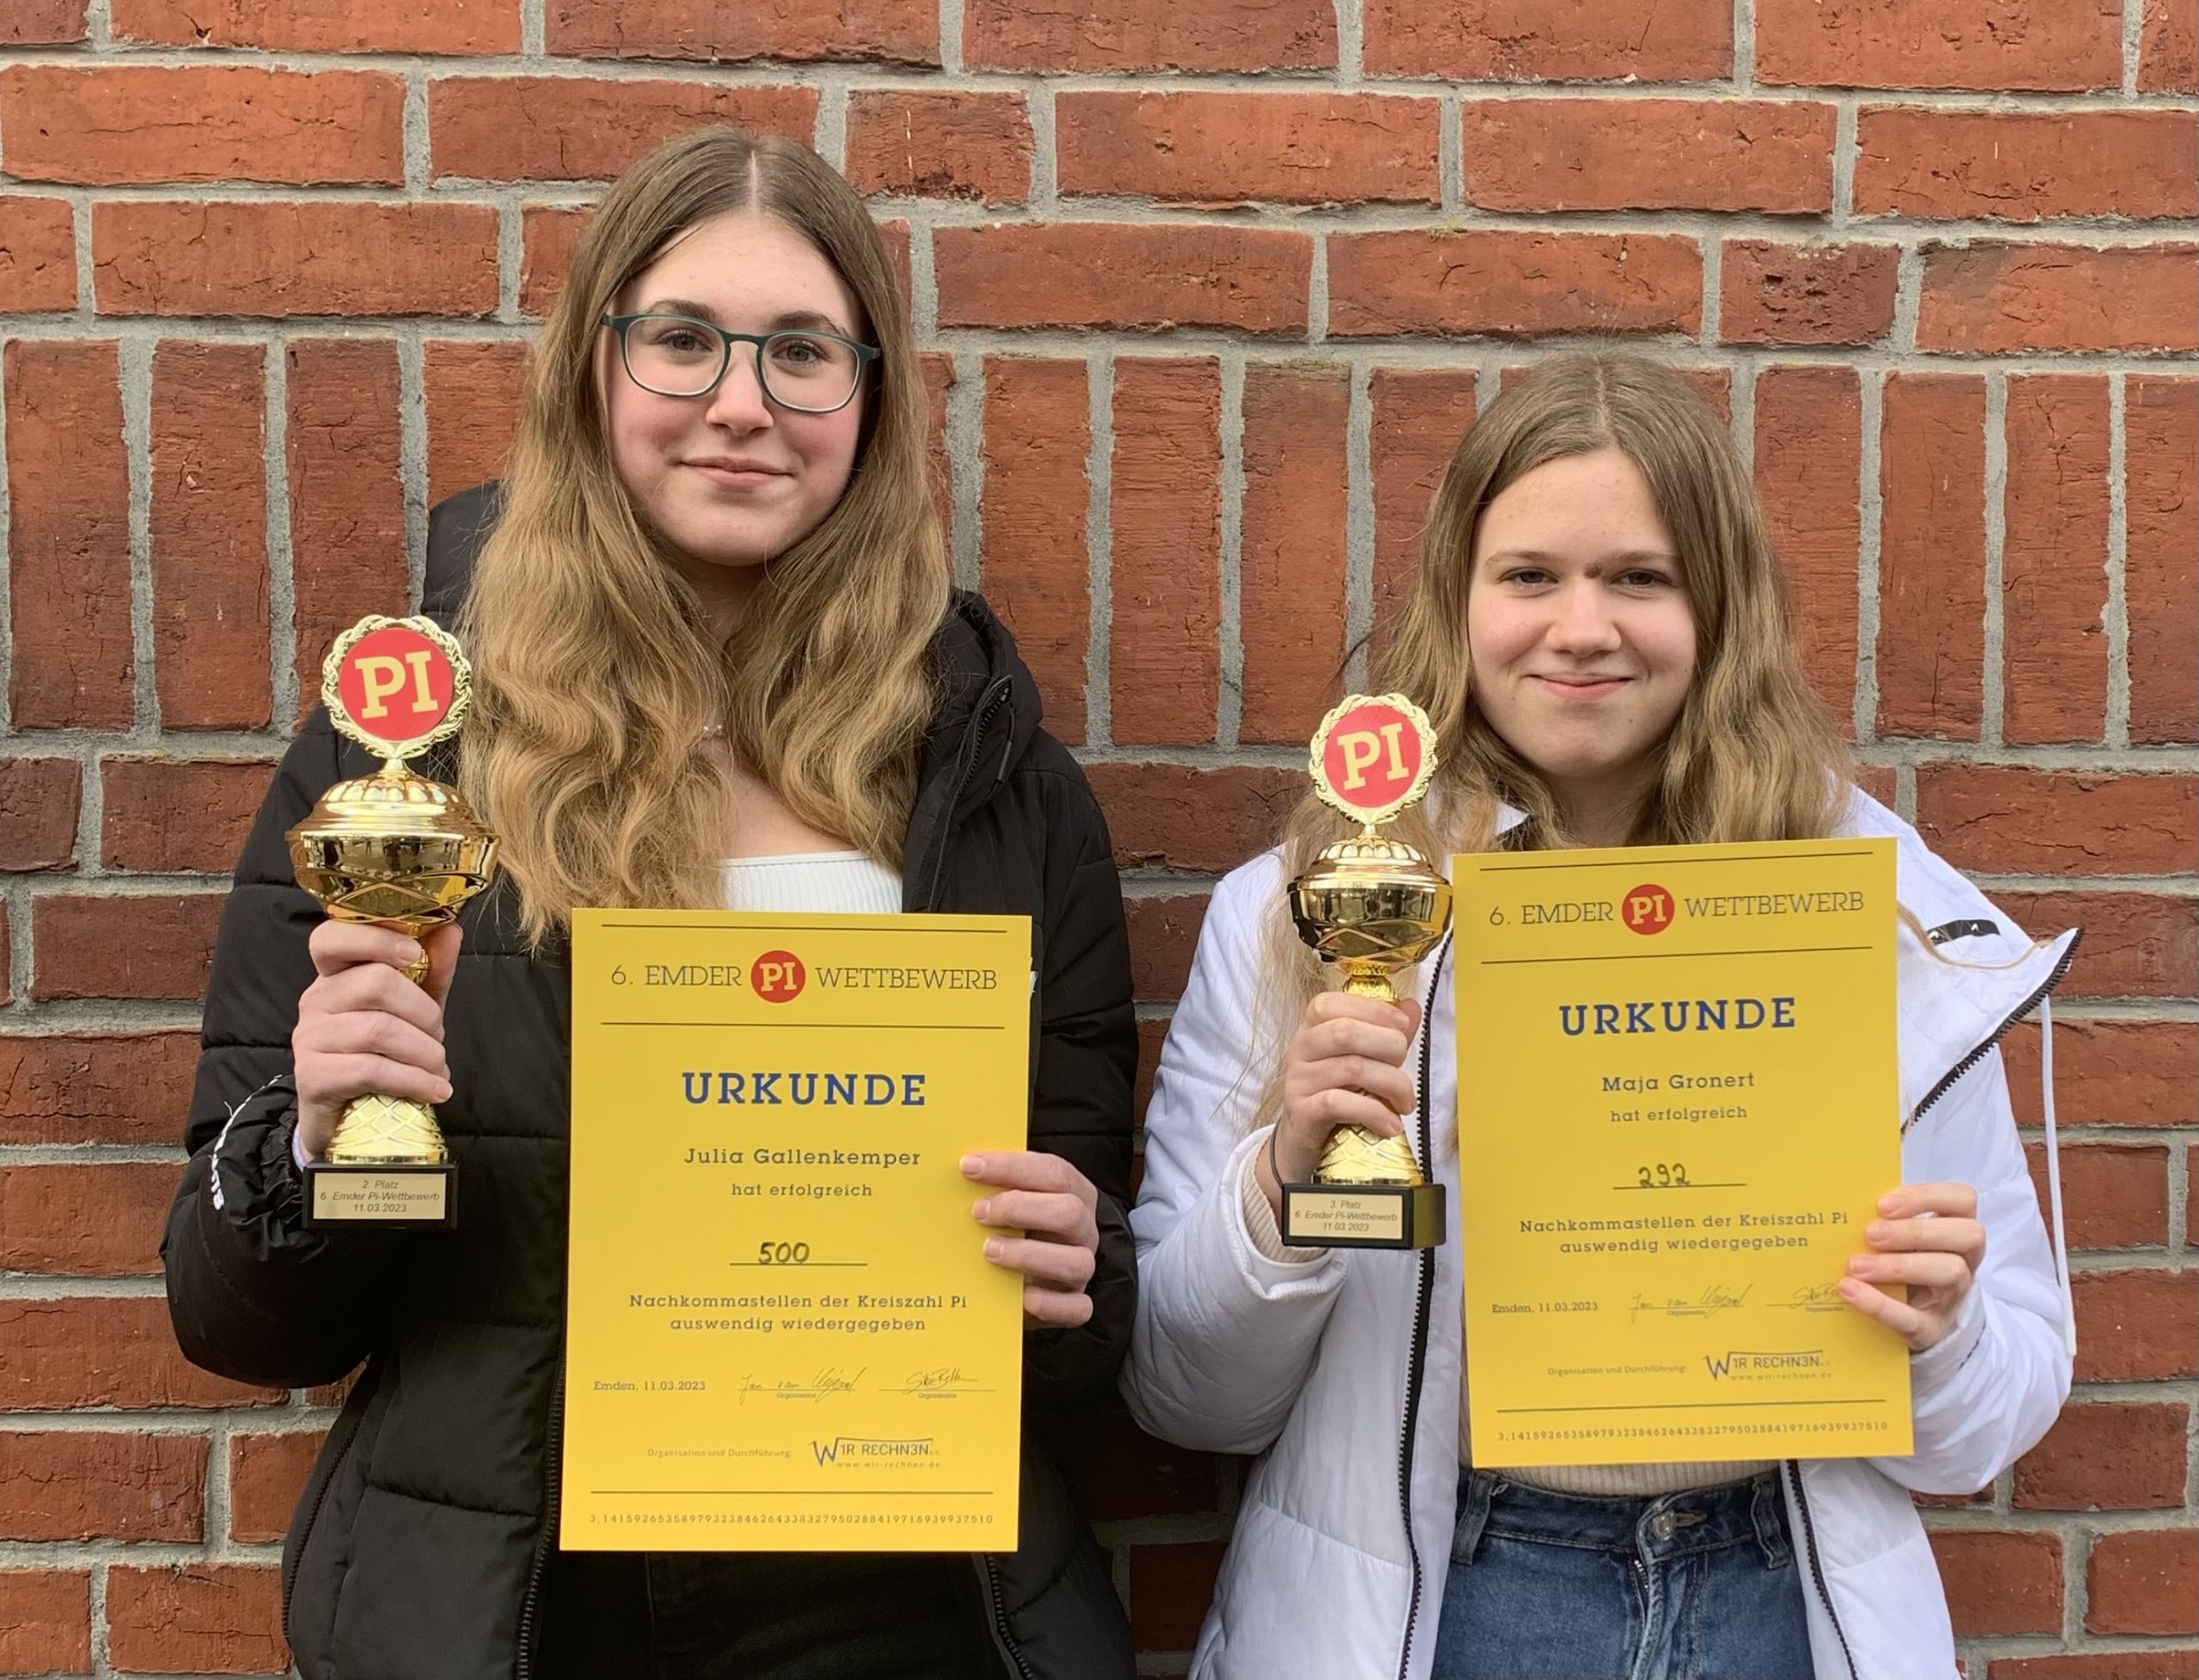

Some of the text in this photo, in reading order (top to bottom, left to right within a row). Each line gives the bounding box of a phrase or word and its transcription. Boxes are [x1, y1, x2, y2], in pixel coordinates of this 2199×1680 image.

[354, 650, 439, 719] PI
[1337, 722, 1410, 791] PI
[1489, 892, 1864, 926] 6. EMDER PI WETTBEWERB
[612, 961, 997, 991] 6. EMDER PI WETTBEWERB
[1559, 996, 1795, 1036] URKUNDE
[682, 1072, 926, 1106] URKUNDE
[1602, 1072, 1755, 1093] Maja Gronert
[1611, 1106, 1747, 1123] hat erfolgreich
[684, 1147, 921, 1169] Julia Gallenkemper
[1638, 1163, 1690, 1187] 292
[375, 1180, 399, 1189] Platz
[732, 1183, 873, 1200] hat erfolgreich
[332, 1192, 365, 1201] Emder
[368, 1192, 440, 1201] Pi-Wettbewerb
[1341, 1201, 1361, 1210] Platz
[1305, 1210, 1333, 1220] Emder
[1520, 1211, 1848, 1232] Nachkommastellen der Kreiszahl Pi
[758, 1241, 810, 1264] 500
[1560, 1235, 1809, 1253] auswendig wiedergegeben
[629, 1294, 967, 1309] Nachkommastellen der Kreiszahl Pi
[1492, 1301, 1599, 1314] Emden, 11.03.2023
[670, 1317, 926, 1333] auswendig wiedergegeben
[1547, 1366, 1604, 1377] Organisation
[594, 1380, 706, 1391] Emden, 11.03.2023
[647, 1448, 706, 1459] Organisation
[708, 1448, 726, 1458] und
